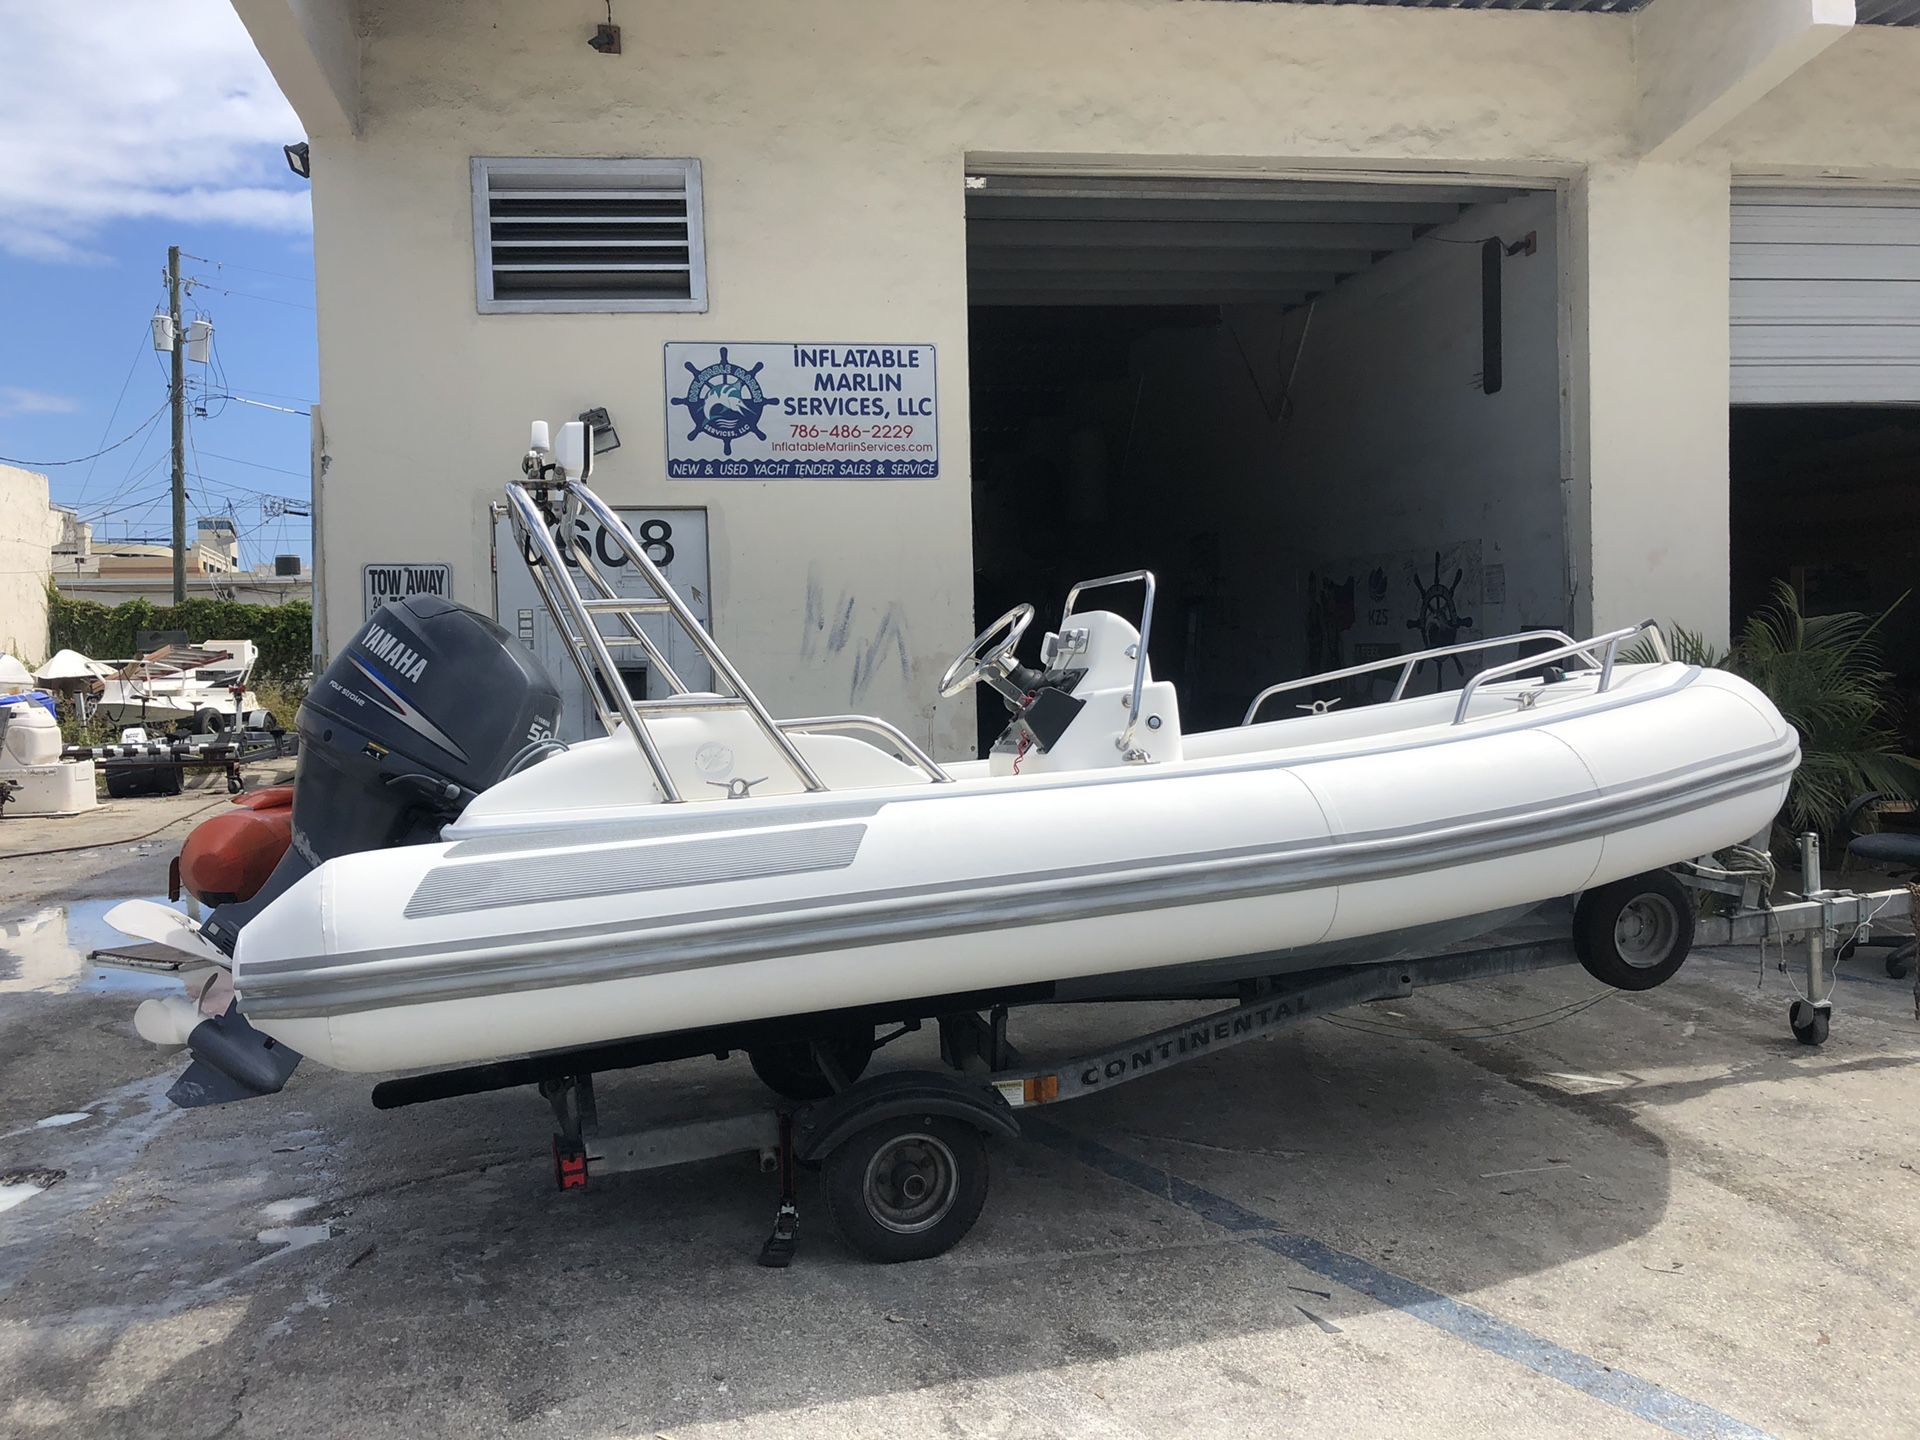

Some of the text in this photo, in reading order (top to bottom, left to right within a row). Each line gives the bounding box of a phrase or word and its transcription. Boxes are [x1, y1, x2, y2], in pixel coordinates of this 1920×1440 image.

[794, 348, 919, 368] INFLATABLE
[814, 373, 902, 392] MARLIN
[784, 397, 932, 419] SERVICES, LLC
[738, 424, 750, 434] LLC
[790, 424, 913, 439] 786-486-2229
[771, 441, 933, 452] InflatableMarlinServices.com
[672, 464, 935, 475] NEW & USED YACHT TENDER SALES & SERVICE
[368, 569, 445, 595] TOW AWAY
[361, 623, 429, 685] YAMAHA
[1081, 997, 1311, 1086] CONTINENTAL
